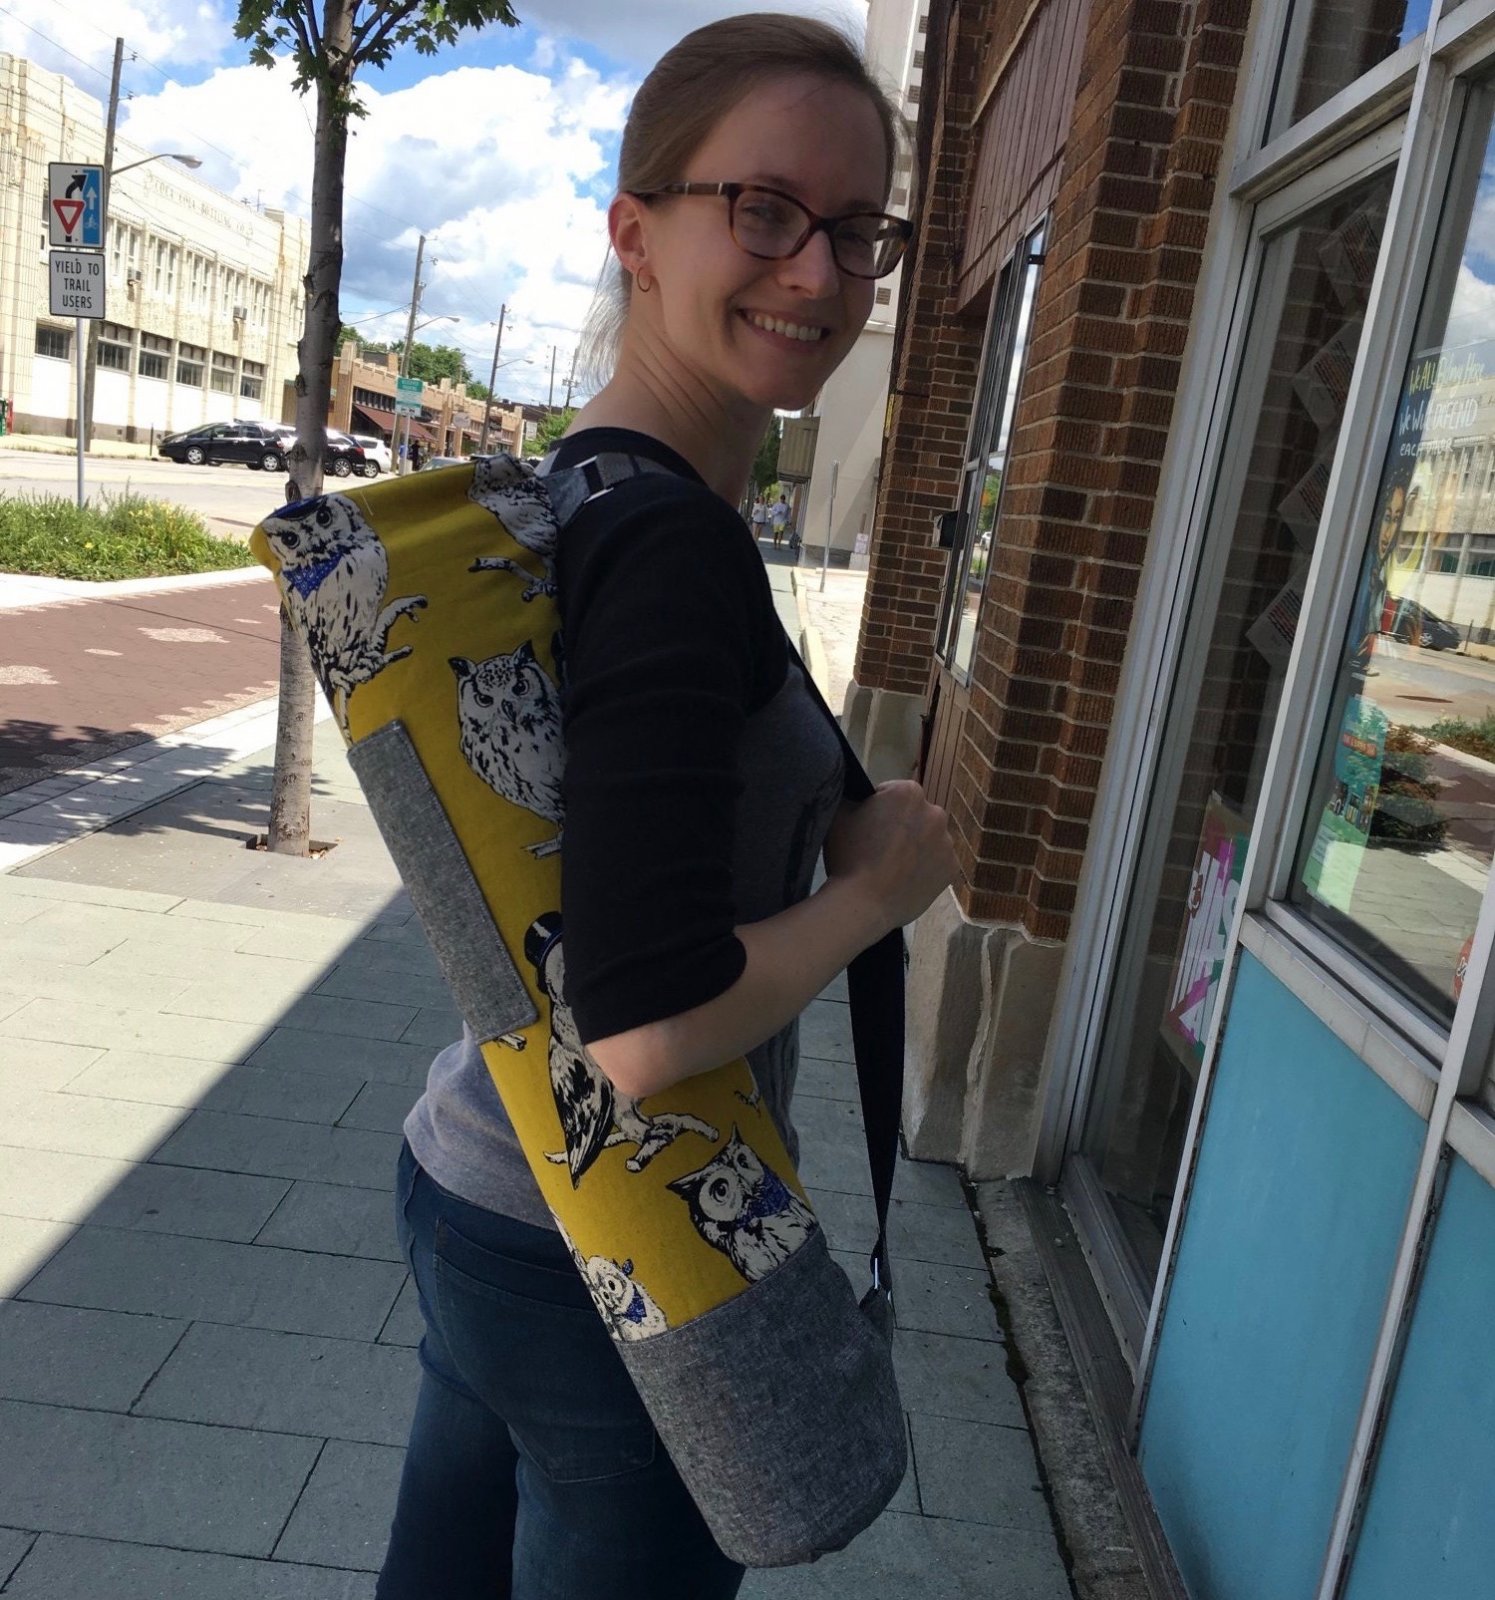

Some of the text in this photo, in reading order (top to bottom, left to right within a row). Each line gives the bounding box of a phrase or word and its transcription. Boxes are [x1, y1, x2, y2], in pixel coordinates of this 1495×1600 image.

[55, 260, 100, 275] YIELD TO
[63, 278, 91, 292] TRAIL
[62, 294, 92, 309] USERS
